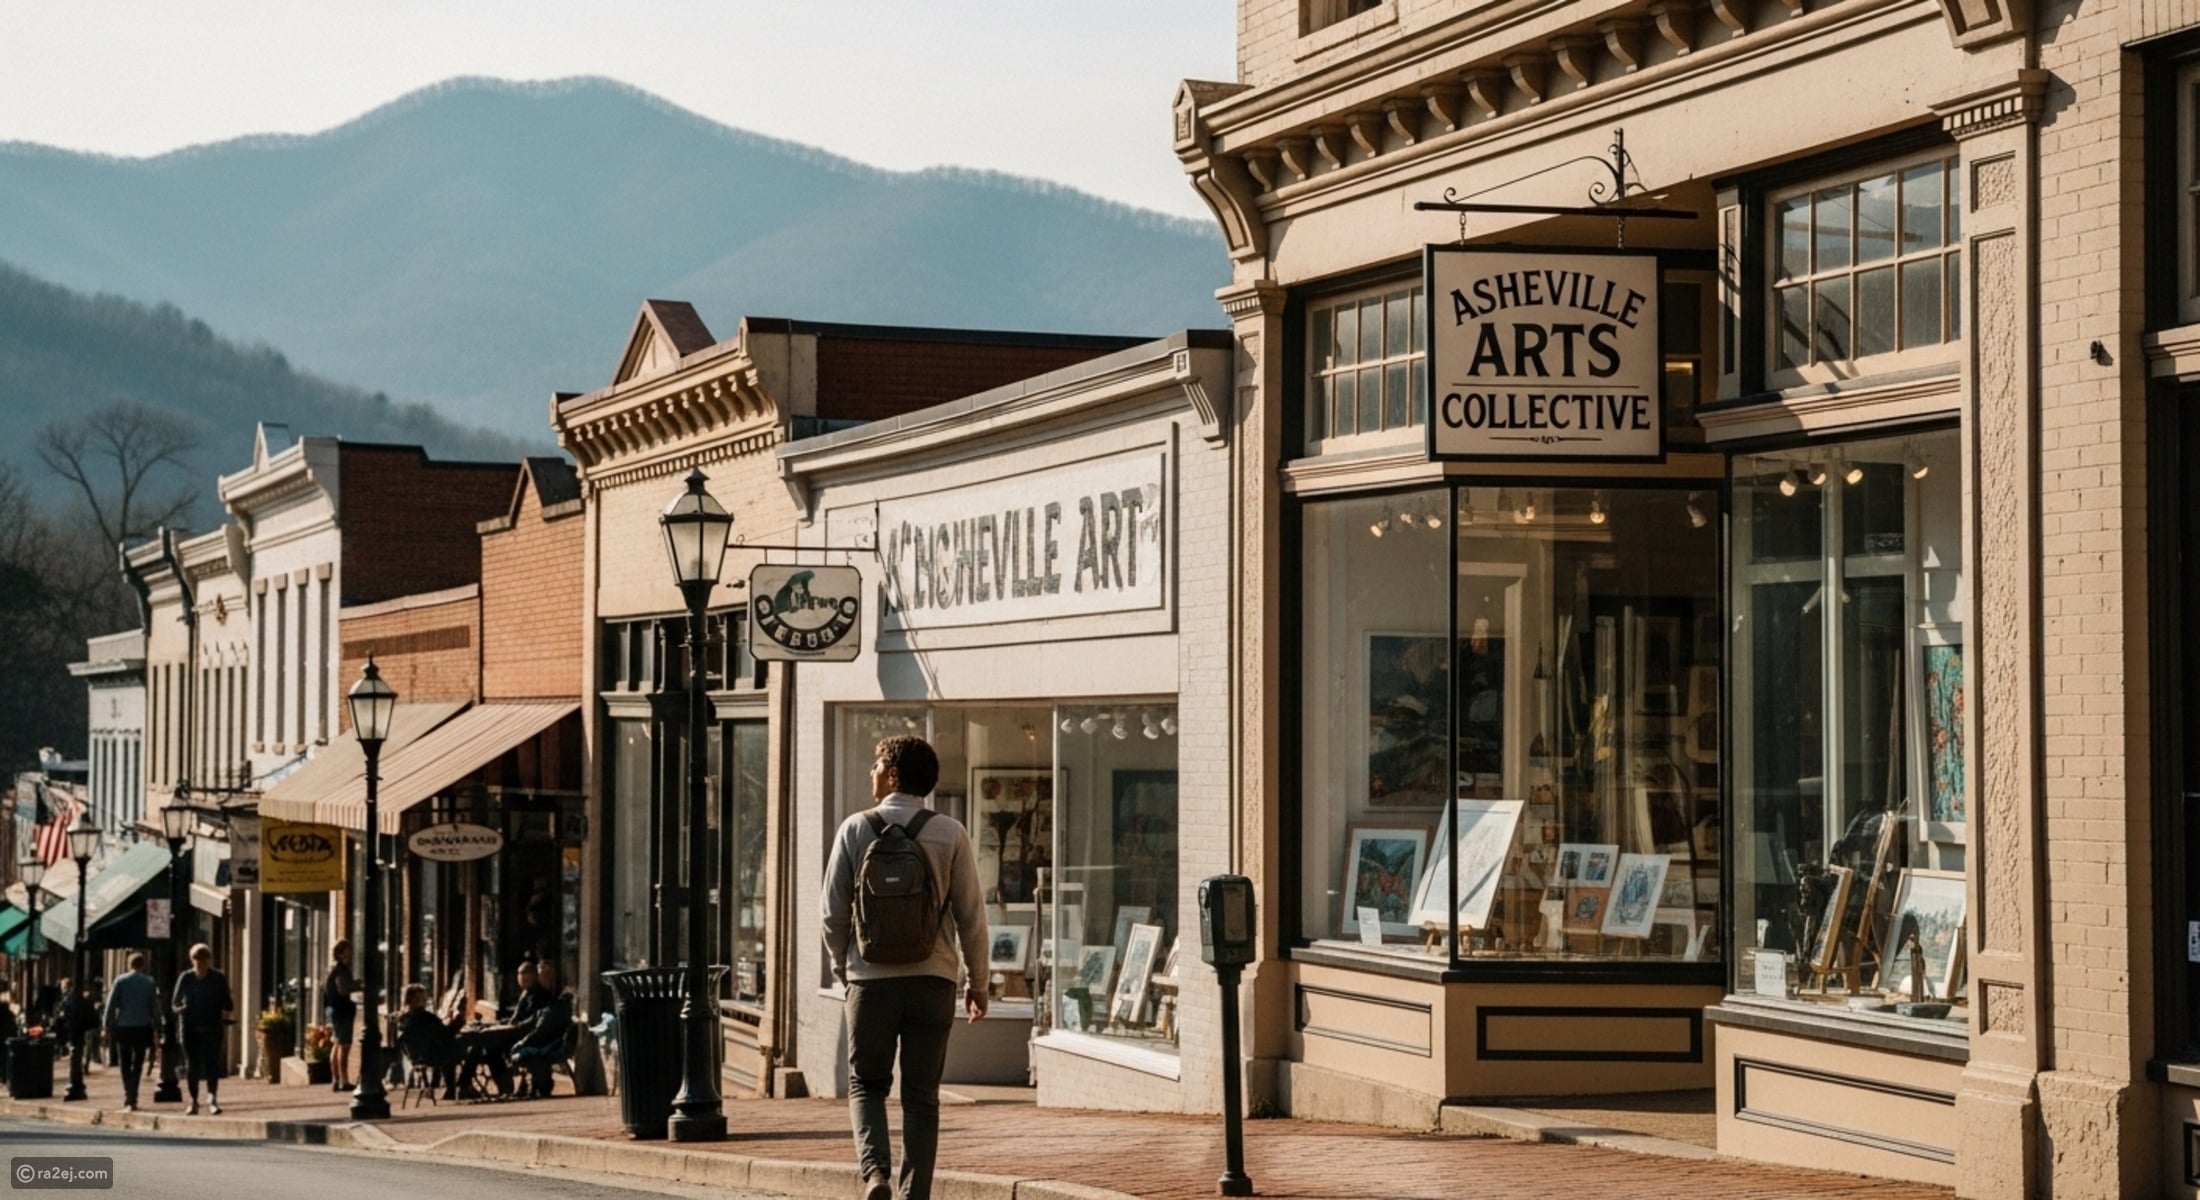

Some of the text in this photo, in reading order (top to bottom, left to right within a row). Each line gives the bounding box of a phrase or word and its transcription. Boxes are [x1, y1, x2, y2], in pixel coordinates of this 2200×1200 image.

[1450, 270, 1647, 329] ASHEVILLE
[1467, 322, 1621, 378] ARTS
[1442, 393, 1651, 430] COLLECTIVE
